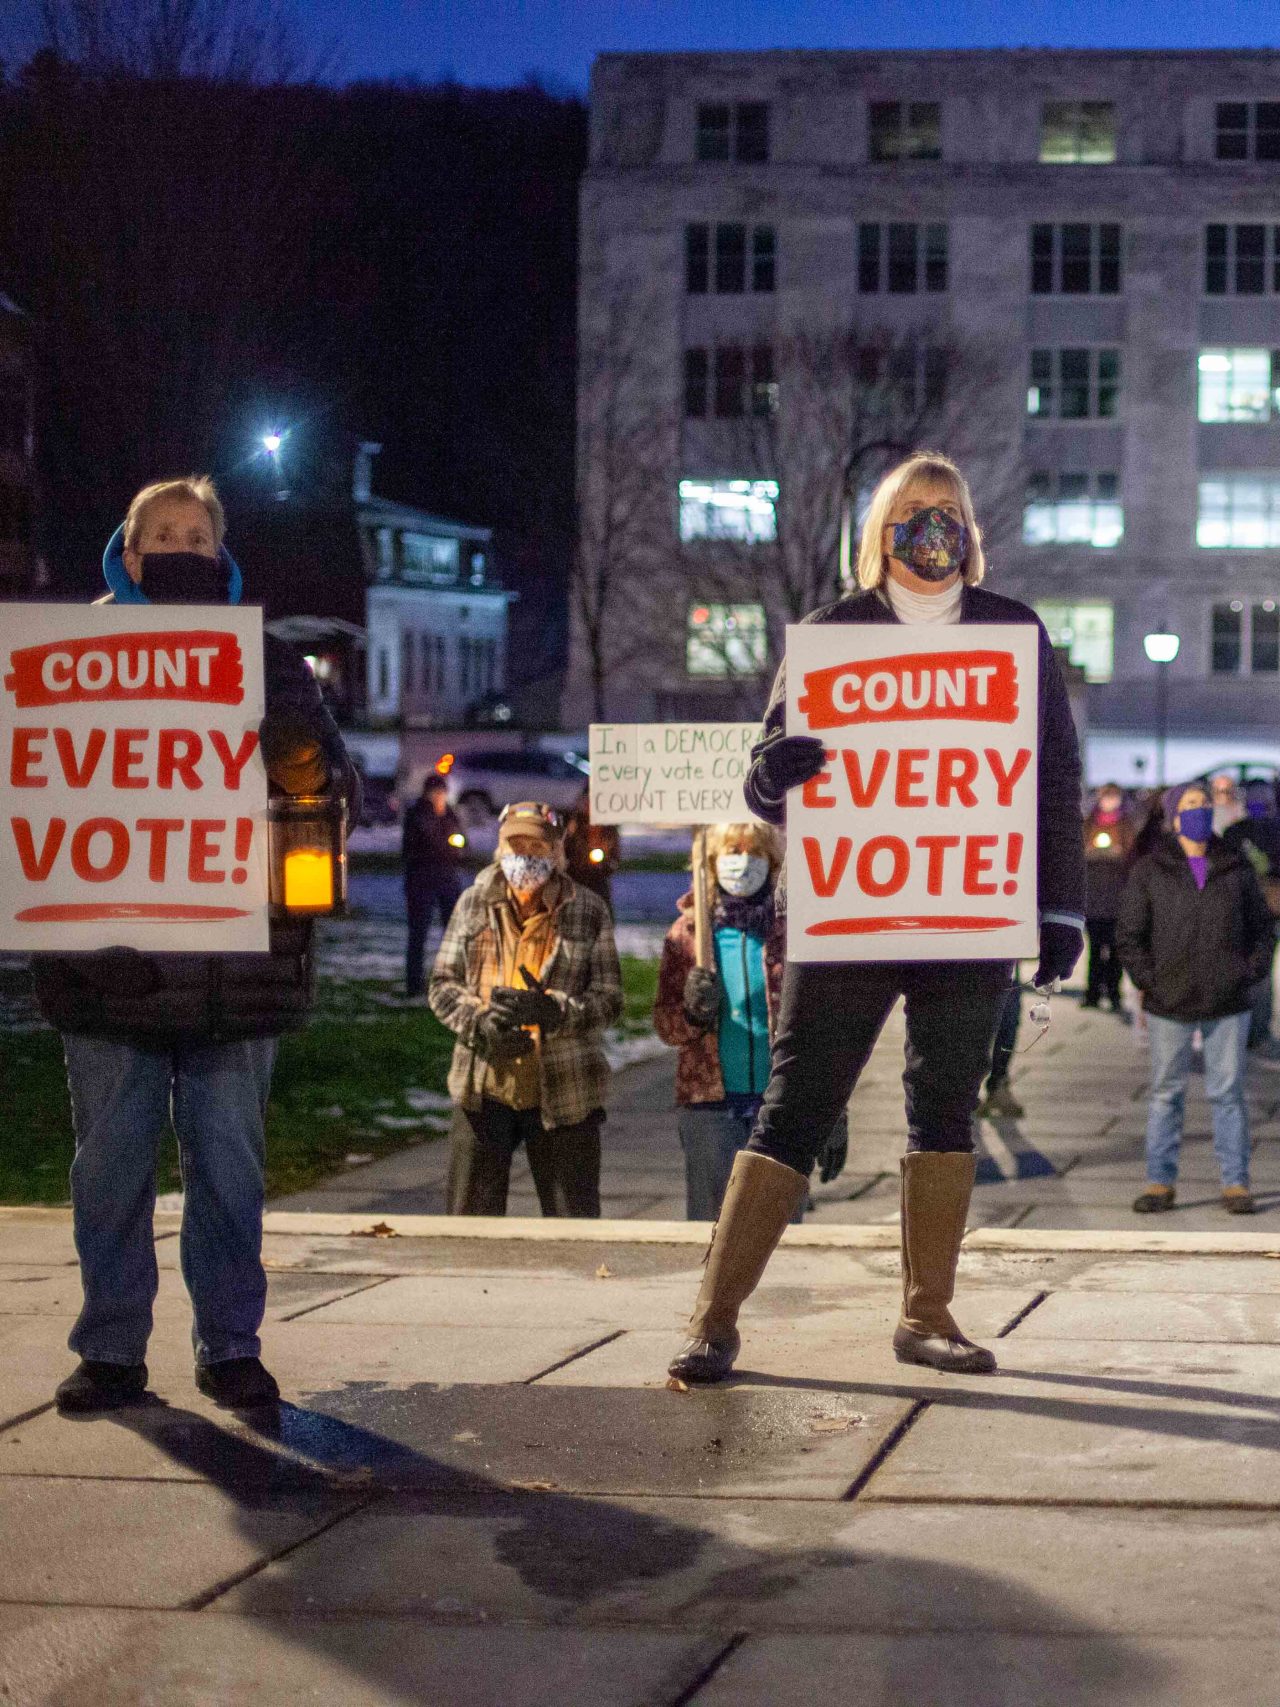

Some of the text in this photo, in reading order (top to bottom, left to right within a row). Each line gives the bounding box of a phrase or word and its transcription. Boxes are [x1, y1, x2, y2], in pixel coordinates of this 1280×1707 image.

[41, 647, 220, 692] COUNT
[831, 666, 997, 713] COUNT
[10, 727, 260, 790] EVERY
[595, 728, 766, 755] In a DEMOCRA
[598, 757, 746, 797] every vote COU
[802, 748, 1032, 808] EVERY
[595, 789, 734, 814] COUNT EVERY
[10, 816, 253, 884] VOTE!
[802, 832, 1024, 898] VOTE!
